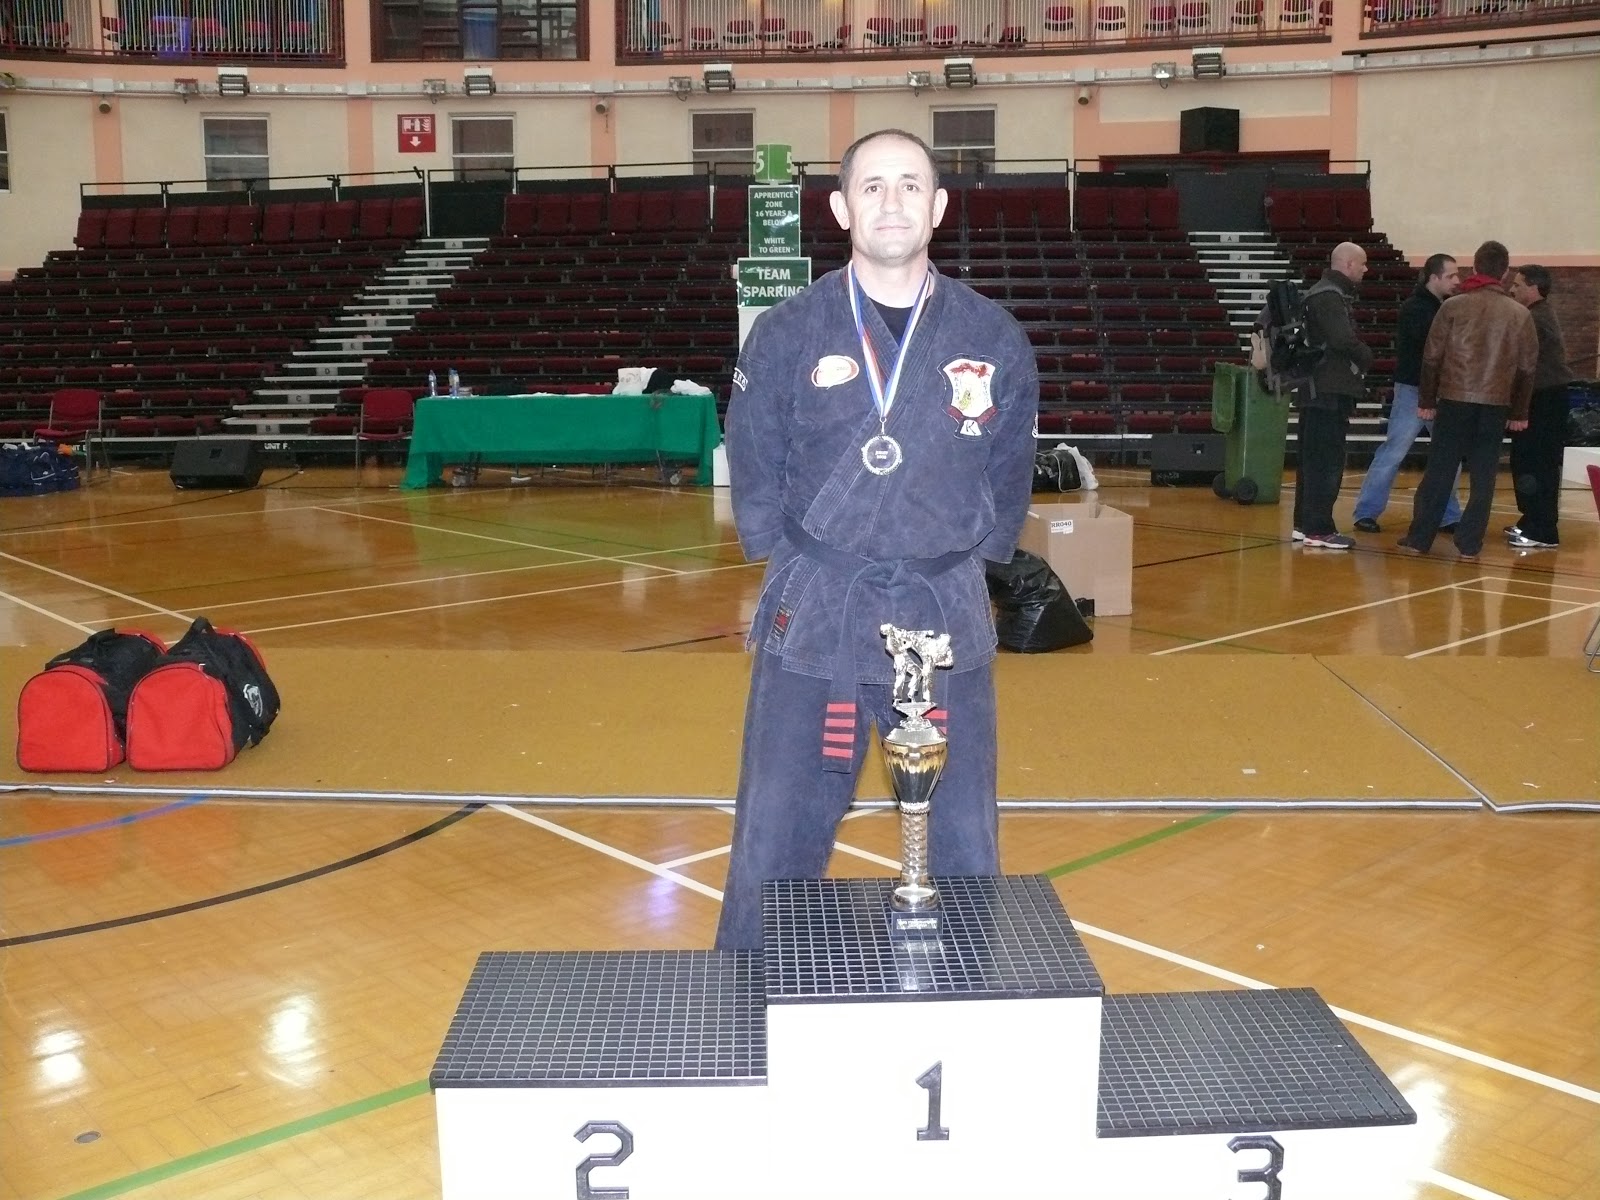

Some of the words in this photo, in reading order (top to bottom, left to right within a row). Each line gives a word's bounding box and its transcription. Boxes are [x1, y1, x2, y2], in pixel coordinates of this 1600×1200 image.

[755, 151, 765, 174] 5
[753, 191, 794, 199] APPRENTICE
[764, 200, 783, 208] ZONE
[764, 209, 787, 217] YEARS
[758, 268, 791, 280] TEAM
[915, 1060, 950, 1141] 1
[573, 1120, 634, 1200] 2
[1226, 1135, 1285, 1200] 3
